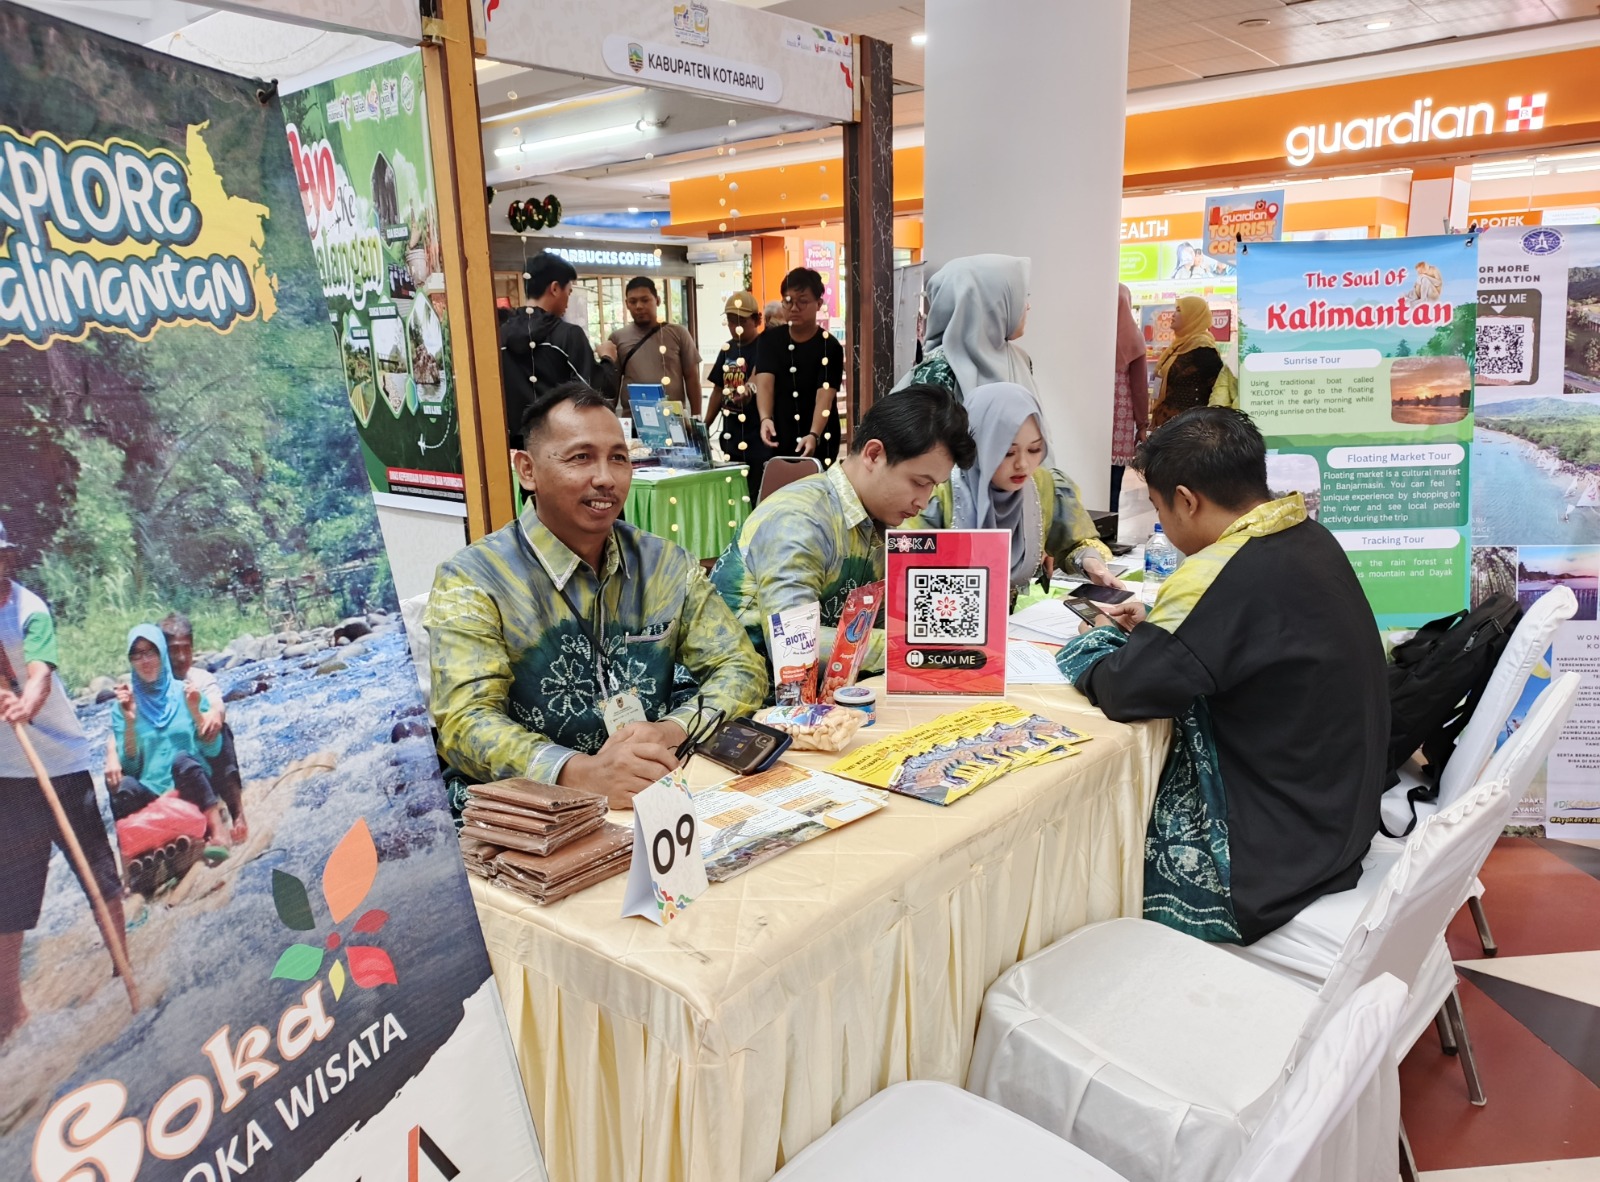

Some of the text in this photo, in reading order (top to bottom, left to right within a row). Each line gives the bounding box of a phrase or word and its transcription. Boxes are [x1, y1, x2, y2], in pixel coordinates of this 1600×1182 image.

[648, 53, 764, 91] KABUPATEN KOTABARU
[1286, 97, 1494, 167] guardian
[0, 141, 193, 246] PLORE
[337, 184, 356, 227] Ke
[1221, 208, 1267, 225] guardian
[1470, 216, 1525, 228] APOTEK
[1120, 219, 1169, 239] EALTH
[1209, 220, 1276, 239] TOURIST
[619, 250, 661, 267] COFFEE
[807, 247, 831, 259] Prodk
[315, 226, 382, 297] alangan
[806, 258, 834, 269] Trending
[1478, 264, 1530, 274] OR MORE
[1304, 267, 1407, 289] The Soul Of
[1478, 274, 1541, 284] ORMATION
[0, 241, 246, 332] alimantan
[1509, 293, 1527, 304] ME
[1266, 297, 1452, 332] Kalimantan
[1283, 355, 1341, 366] Sunrise Tour
[1250, 376, 1374, 388] Using traditional boat called
[1303, 389, 1313, 397] go
[1347, 385, 1375, 395] floating
[1250, 395, 1374, 407] market in the early morning while
[1250, 408, 1279, 418] enjoying
[1280, 407, 1305, 416] sunrise
[1315, 407, 1328, 415] the
[1328, 405, 1345, 414] boat.
[1347, 450, 1452, 464] Floating Market Tour
[1323, 471, 1355, 481] Floating
[1356, 470, 1384, 479] market
[1385, 470, 1393, 479] is
[1401, 468, 1432, 478] cultural
[1433, 467, 1461, 477] market
[1323, 483, 1331, 491] in
[1335, 481, 1386, 492] Banjarmasin.
[1390, 480, 1406, 489] You
[1430, 479, 1445, 488] feel
[1323, 489, 1461, 503] unique experience by shopping on
[1323, 501, 1461, 513] the river and see local people
[1323, 512, 1409, 524] activity during the trip
[1361, 535, 1425, 546] Tracking Tour
[1369, 557, 1453, 567] the rain forest at
[1368, 569, 1406, 578] mountain
[1409, 568, 1425, 577] and
[1429, 567, 1453, 579] Dayak
[785, 632, 807, 646] BIOTA
[928, 654, 976, 665] SCAN ME
[652, 813, 695, 875] 09
[31, 980, 335, 1182] Soka
[182, 1119, 274, 1182] OKA
[274, 1012, 408, 1131] WISATA
